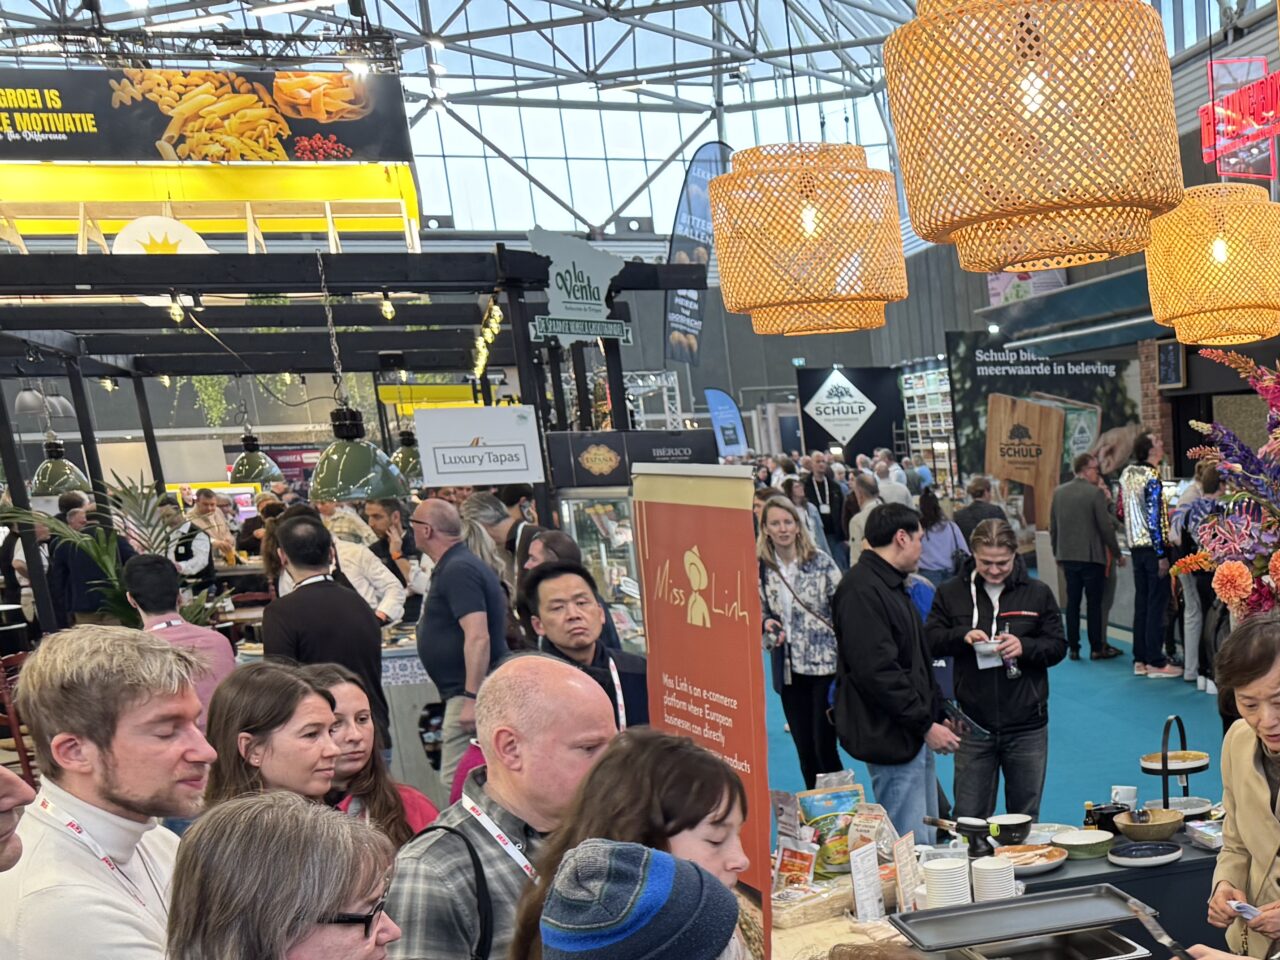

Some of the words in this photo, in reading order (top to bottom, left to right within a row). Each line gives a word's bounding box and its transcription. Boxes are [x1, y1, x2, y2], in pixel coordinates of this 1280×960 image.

[0, 88, 43, 109] GROEI
[44, 89, 62, 109] IS
[14, 112, 97, 133] MOTIVATIE
[572, 261, 584, 282] la
[555, 269, 600, 301] Venta
[975, 349, 1017, 363] Schulp
[976, 362, 1051, 376] meerwaarde
[1053, 362, 1065, 375] in
[1067, 361, 1116, 377] beleving
[815, 403, 866, 416] SCHULP
[442, 452, 483, 467] Luxury
[484, 450, 520, 466] Tapas
[652, 447, 692, 457] IBÉRICO
[999, 446, 1042, 458] SCHULP
[654, 559, 685, 606] Miss
[712, 570, 749, 625] Linh
[662, 672, 675, 689] Miss
[675, 675, 688, 692] Linh
[693, 686, 701, 698] an
[702, 689, 738, 710] e-commerce
[663, 689, 687, 716] platform
[688, 698, 703, 718] where
[704, 703, 733, 728] European
[692, 724, 702, 736] can
[703, 722, 726, 748] directly
